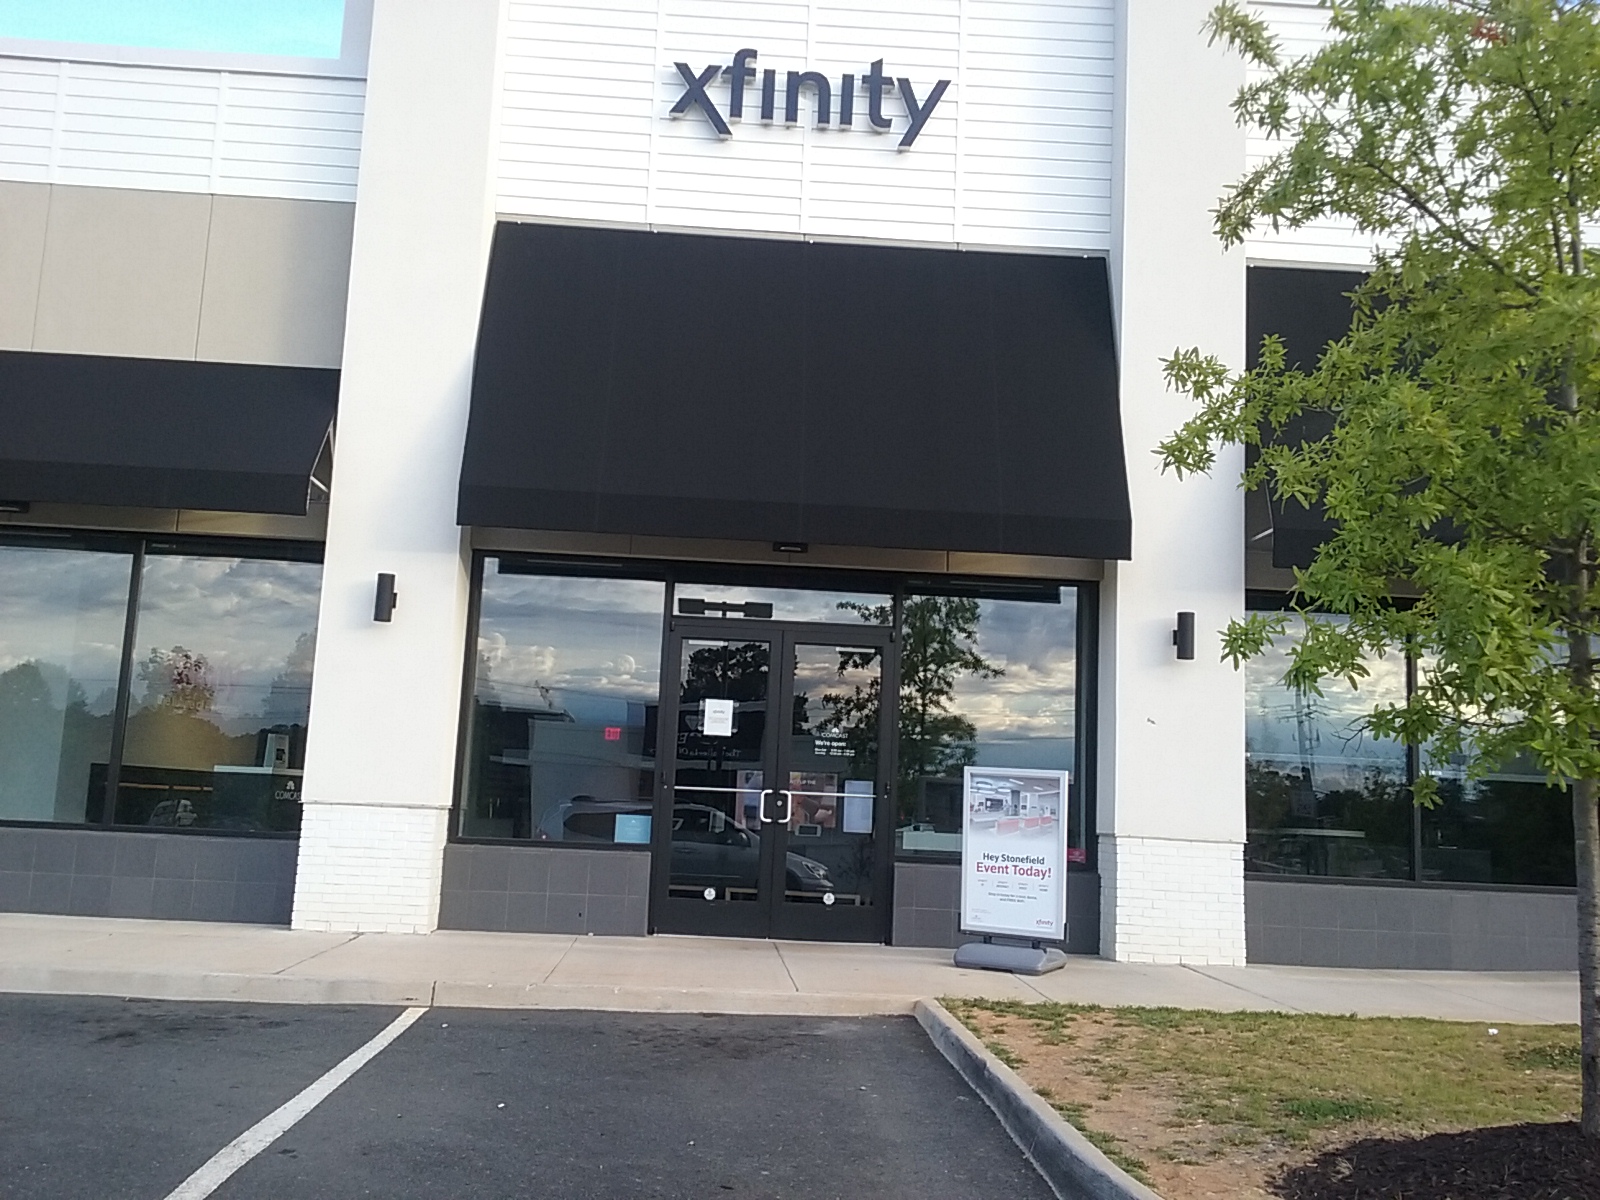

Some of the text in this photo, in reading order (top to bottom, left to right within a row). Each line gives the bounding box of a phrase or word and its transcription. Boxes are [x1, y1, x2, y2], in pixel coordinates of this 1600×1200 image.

[669, 48, 952, 151] xfinity
[275, 790, 302, 800] COMCAS
[982, 852, 1045, 865] Hey Stonefield
[976, 861, 1052, 881] Event Today!
